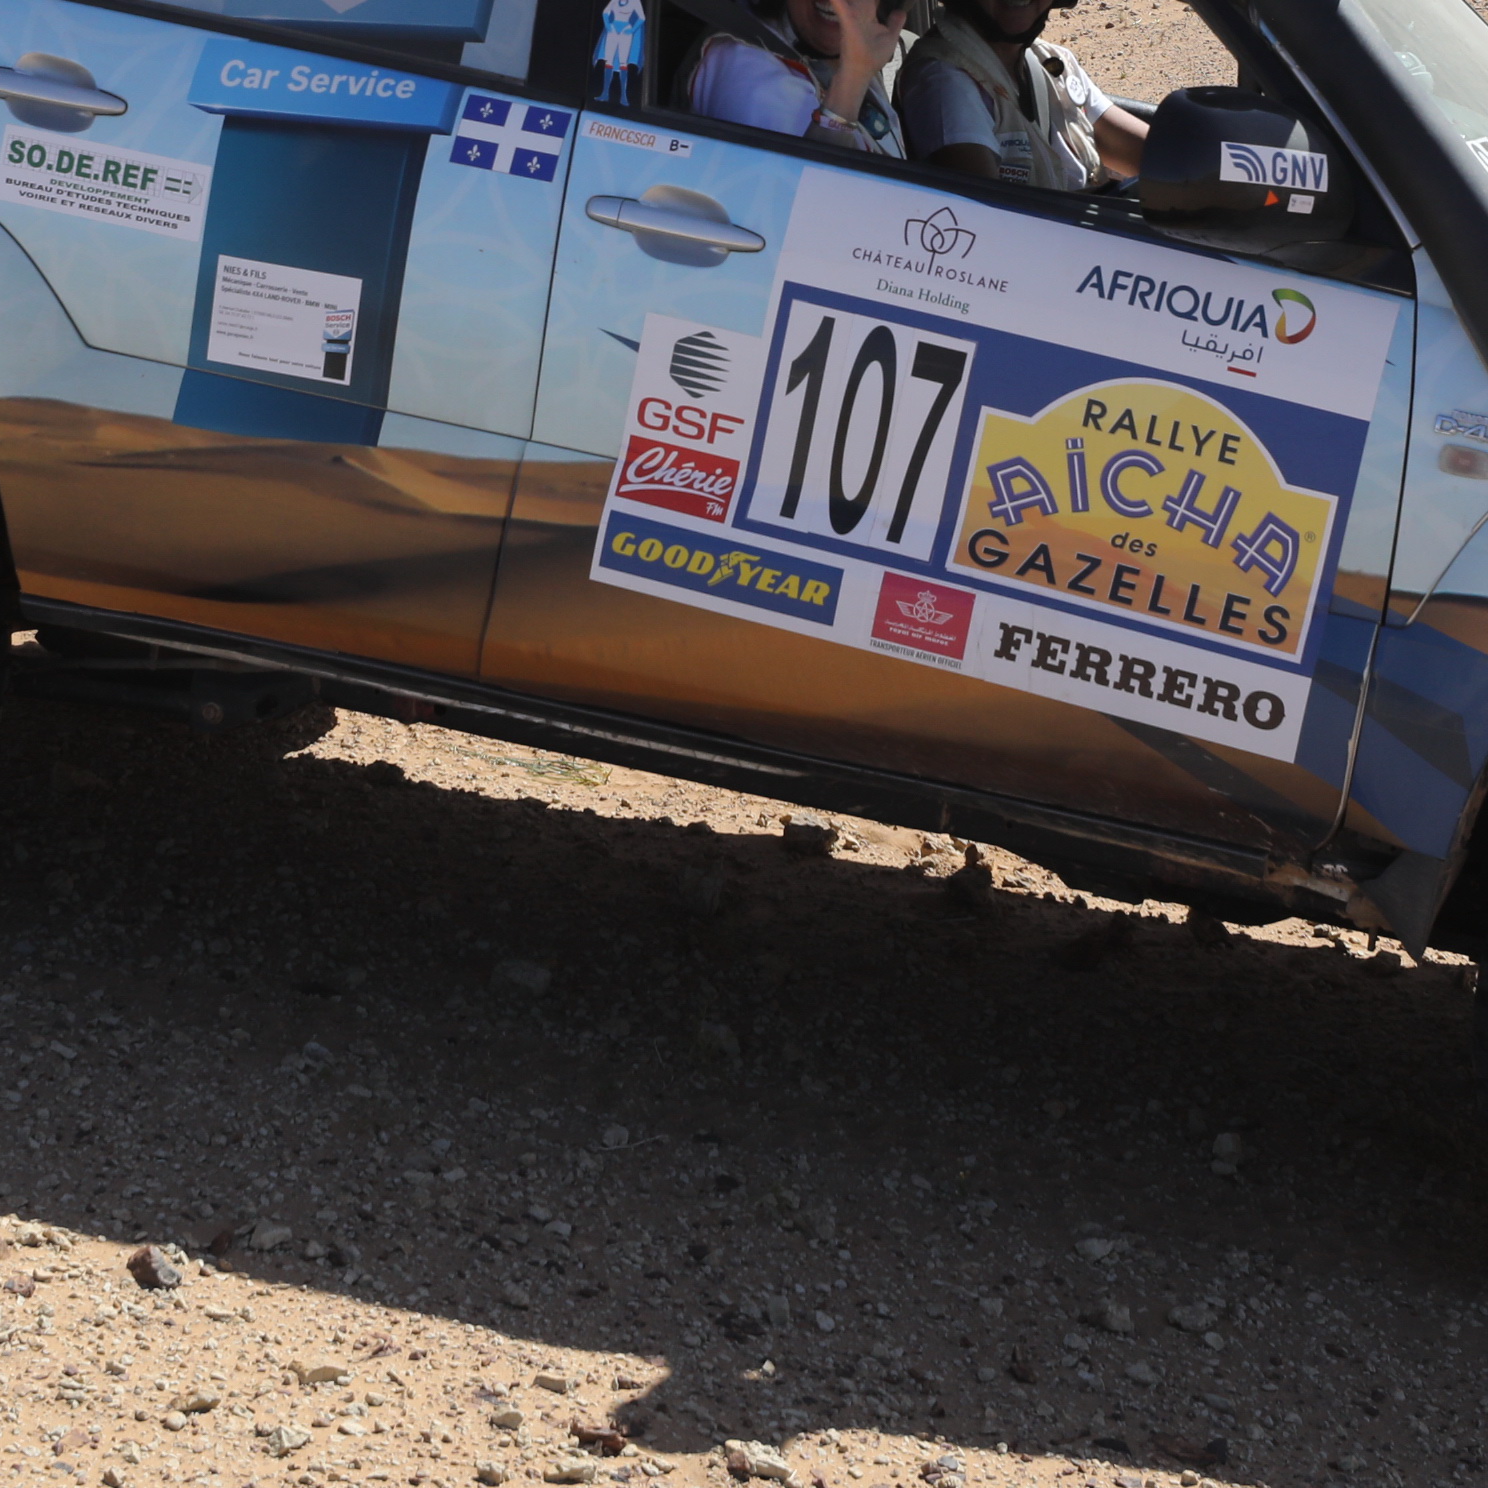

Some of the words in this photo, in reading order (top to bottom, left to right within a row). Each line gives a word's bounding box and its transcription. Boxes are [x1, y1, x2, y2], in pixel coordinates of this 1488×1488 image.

[220, 60, 280, 89] Car
[287, 65, 416, 99] Service
[590, 121, 656, 148] FRANCESCA
[7, 140, 159, 191] SO.DE.REF
[1272, 151, 1324, 190] GNV
[5, 177, 54, 194] BUREAU
[56, 187, 112, 206] D'ETUDES
[116, 200, 191, 223] TECHNIQUES
[19, 190, 57, 204] VOIRIE
[61, 198, 76, 208] ET
[79, 202, 132, 220] RESEAUX
[135, 215, 178, 230] DIVERS
[50, 178, 150, 205] DEVELOPPEMENT
[223, 265, 241, 276] NIES
[243, 269, 249, 277] &
[250, 271, 267, 280] FILS
[852, 248, 925, 274] CHÂTEAU
[934, 265, 1009, 293] ROSLANE
[326, 314, 352, 322] BOSCH
[876, 278, 914, 298] Diana
[918, 288, 970, 314] Holding
[1075, 265, 1269, 339] AFRIQUIA
[637, 397, 745, 444] GSF
[780, 316, 968, 545] 107
[1082, 398, 1241, 465] RALLYE
[626, 447, 734, 496] Chérie
[986, 437, 1300, 598] AÏCHA
[1111, 532, 1158, 558] des
[967, 528, 1291, 645] GAZELLES
[870, 639, 914, 657] TRANSPORTEUR
[937, 657, 962, 670] OFFICIEL
[994, 622, 1286, 730] FERRERO
